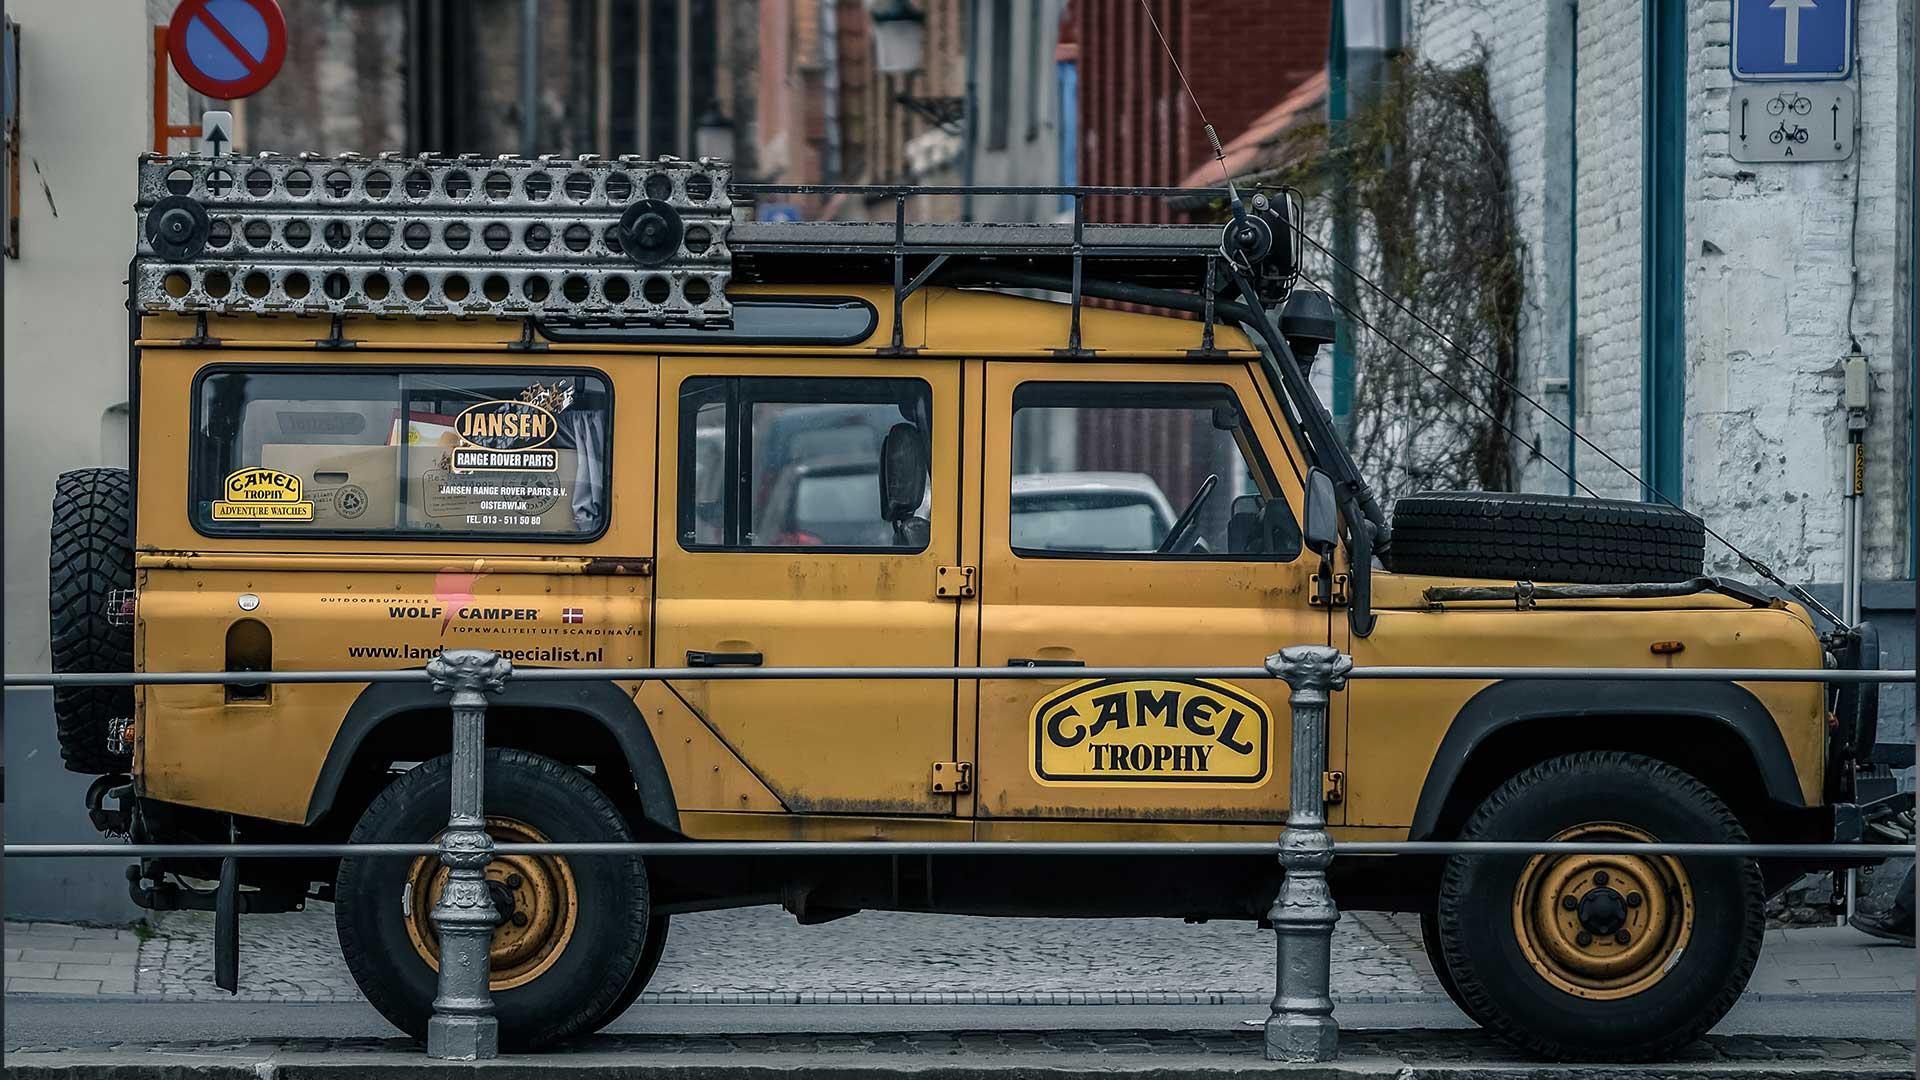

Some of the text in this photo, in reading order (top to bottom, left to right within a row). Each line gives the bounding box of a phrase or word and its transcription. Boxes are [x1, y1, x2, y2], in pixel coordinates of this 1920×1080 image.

[1785, 146, 1793, 156] A
[462, 413, 547, 438] JANSEN
[457, 452, 554, 467] RANGE ROVER PARTS
[1856, 445, 1864, 491] 6233
[231, 473, 296, 492] CAMEL
[244, 490, 284, 499] TROPHY
[440, 486, 472, 495] JANSEN
[473, 486, 499, 495] RANGE
[500, 487, 526, 496] ROVER
[527, 487, 552, 496] PARTS
[553, 487, 568, 497] B.V.
[220, 507, 307, 516] ADVENTURE WATCHES
[480, 500, 527, 511] OISTERWIJK
[466, 515, 481, 525] TEL.
[482, 515, 498, 525] 013
[503, 516, 518, 525] 511
[519, 516, 530, 525] 50
[531, 516, 541, 526] 80
[388, 606, 539, 620] WOLF CAMPER
[452, 626, 537, 635] TOPKWALITEIT
[1046, 689, 1254, 755] CAMEL
[1087, 742, 1215, 772] TROPHY
